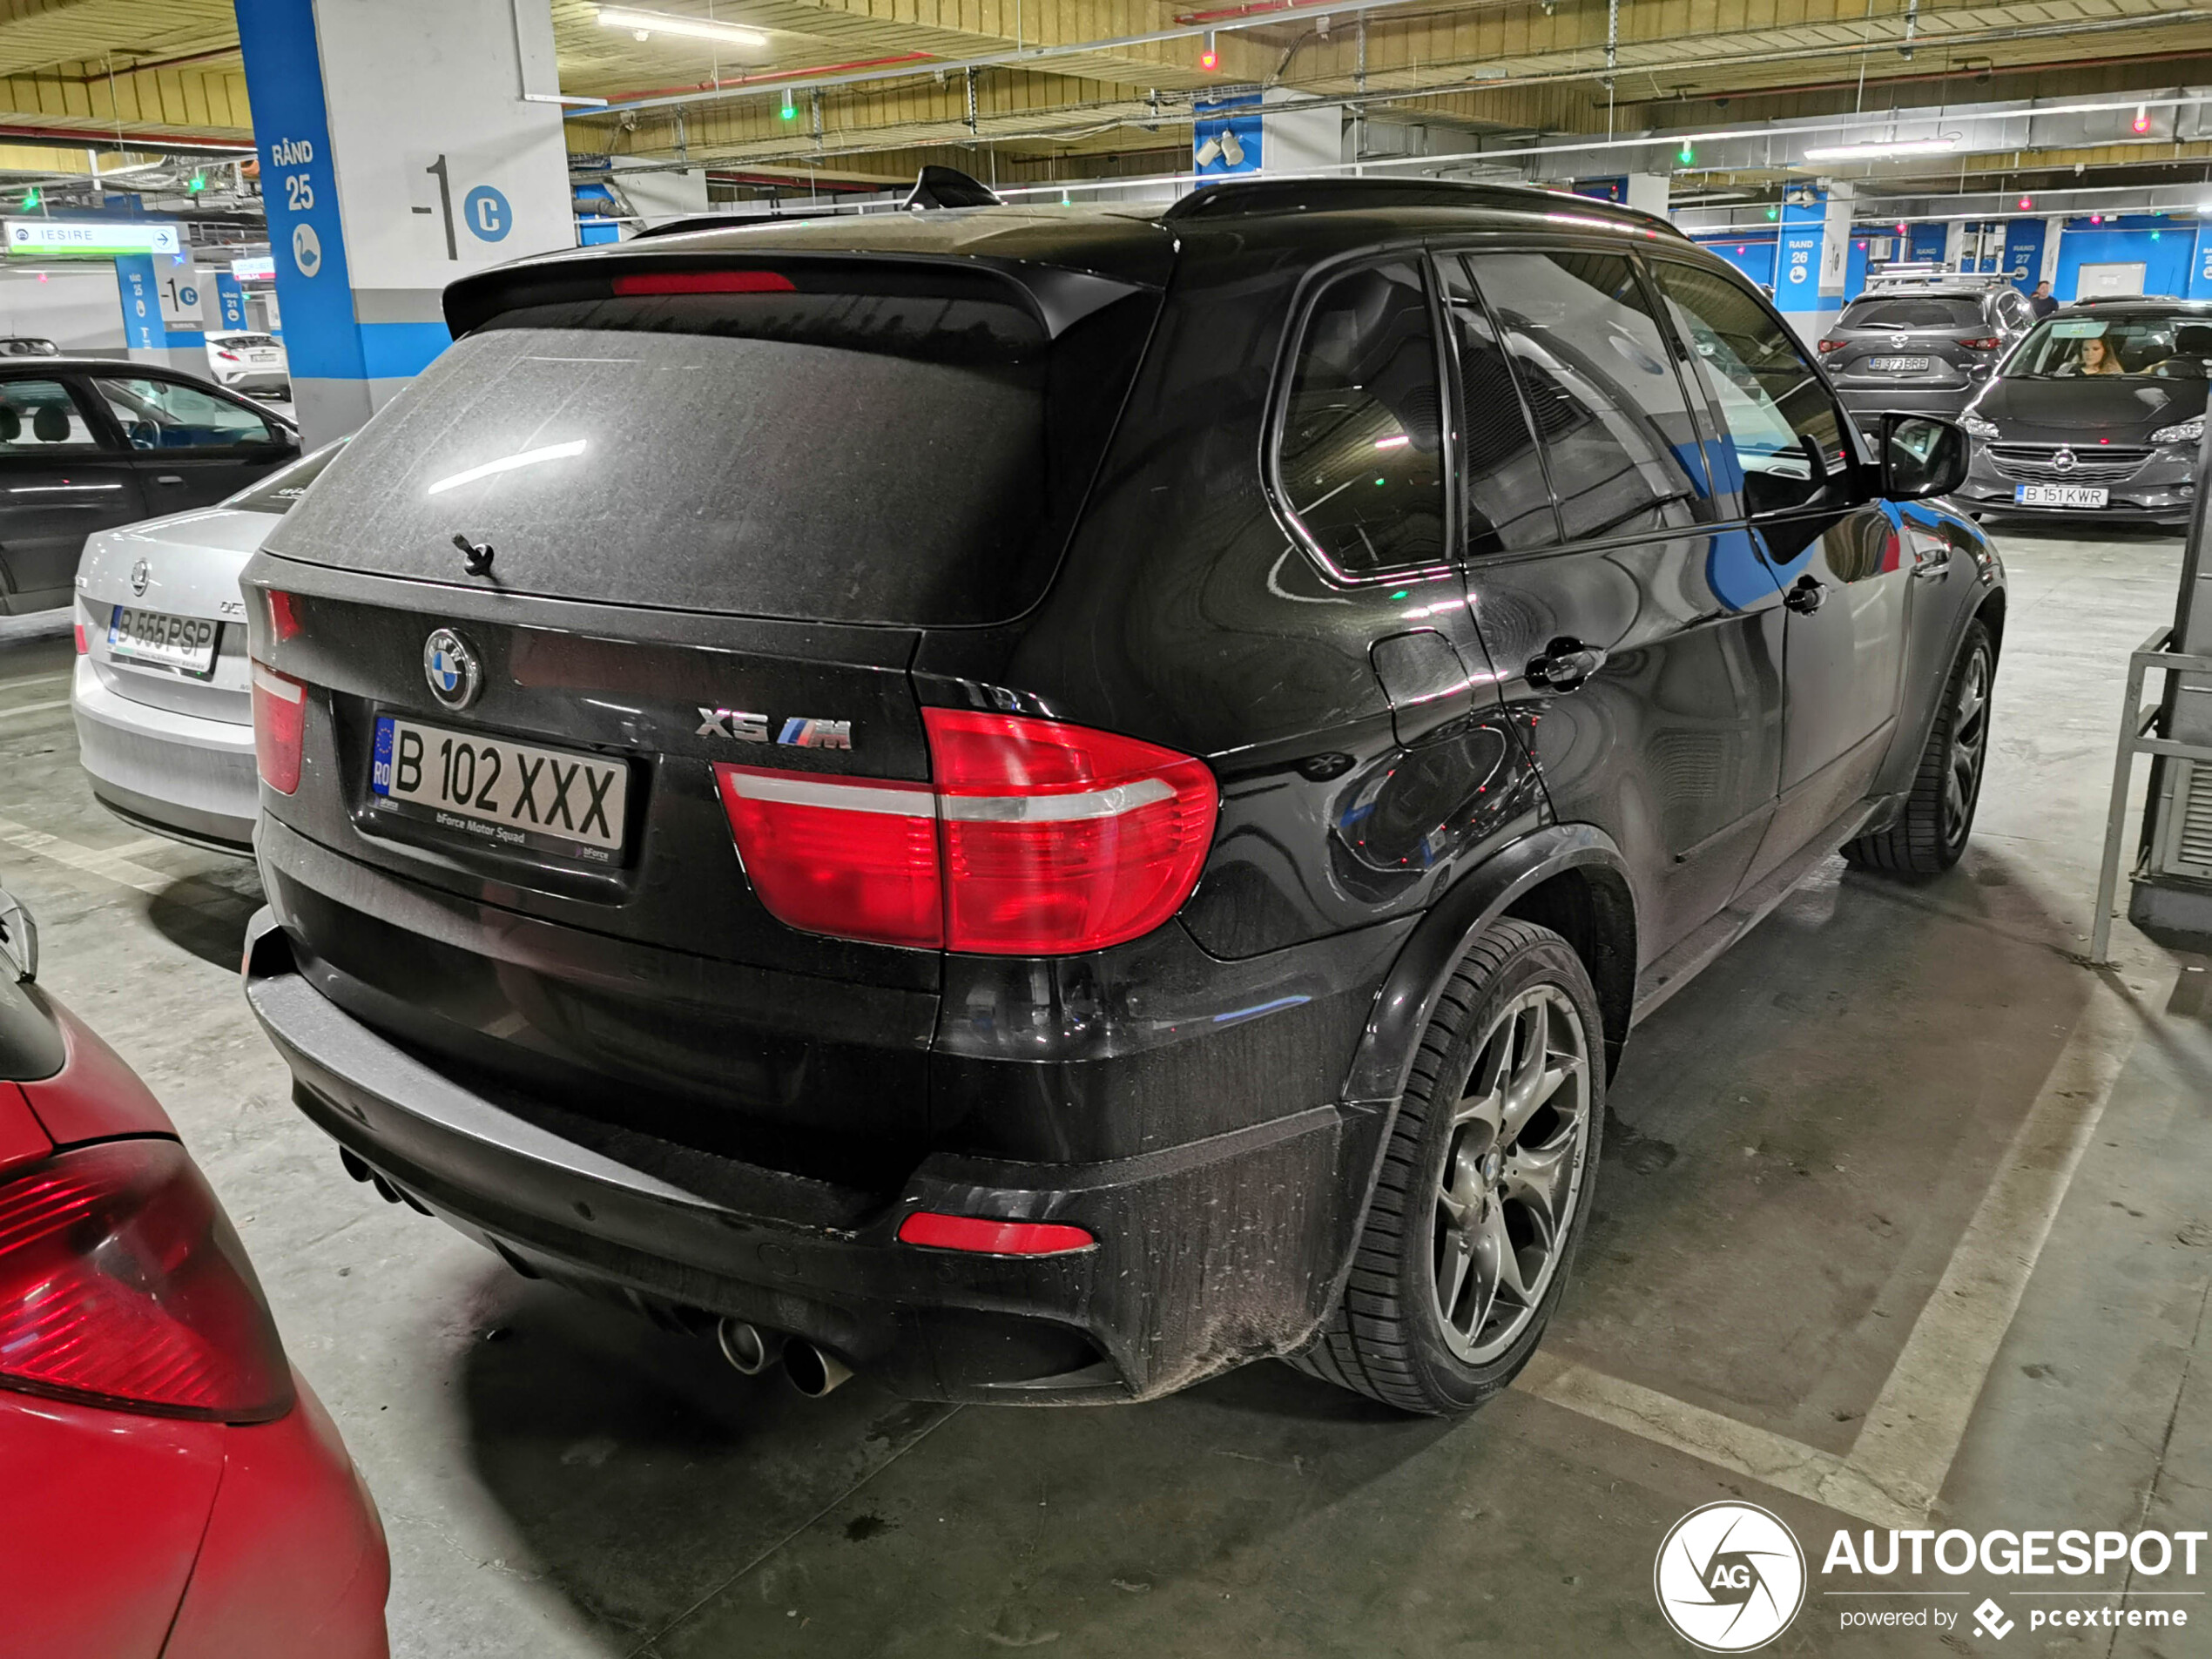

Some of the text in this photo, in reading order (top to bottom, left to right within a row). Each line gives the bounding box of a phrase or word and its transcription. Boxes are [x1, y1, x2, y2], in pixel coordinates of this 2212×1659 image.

[272, 138, 314, 167] RÂND
[286, 174, 314, 211] 25
[477, 198, 500, 232] C
[41, 230, 93, 240] IESIRE
[1791, 252, 1808, 264] 26
[2015, 254, 2030, 264] 27
[2027, 488, 2101, 503] B 151 KWR
[118, 610, 212, 657] B 555 PSP
[695, 706, 769, 743] X5
[374, 760, 390, 786] RO
[396, 729, 617, 840] B 102 XXX
[436, 812, 525, 845] bForce Motor Squad
[583, 847, 610, 860] bForce
